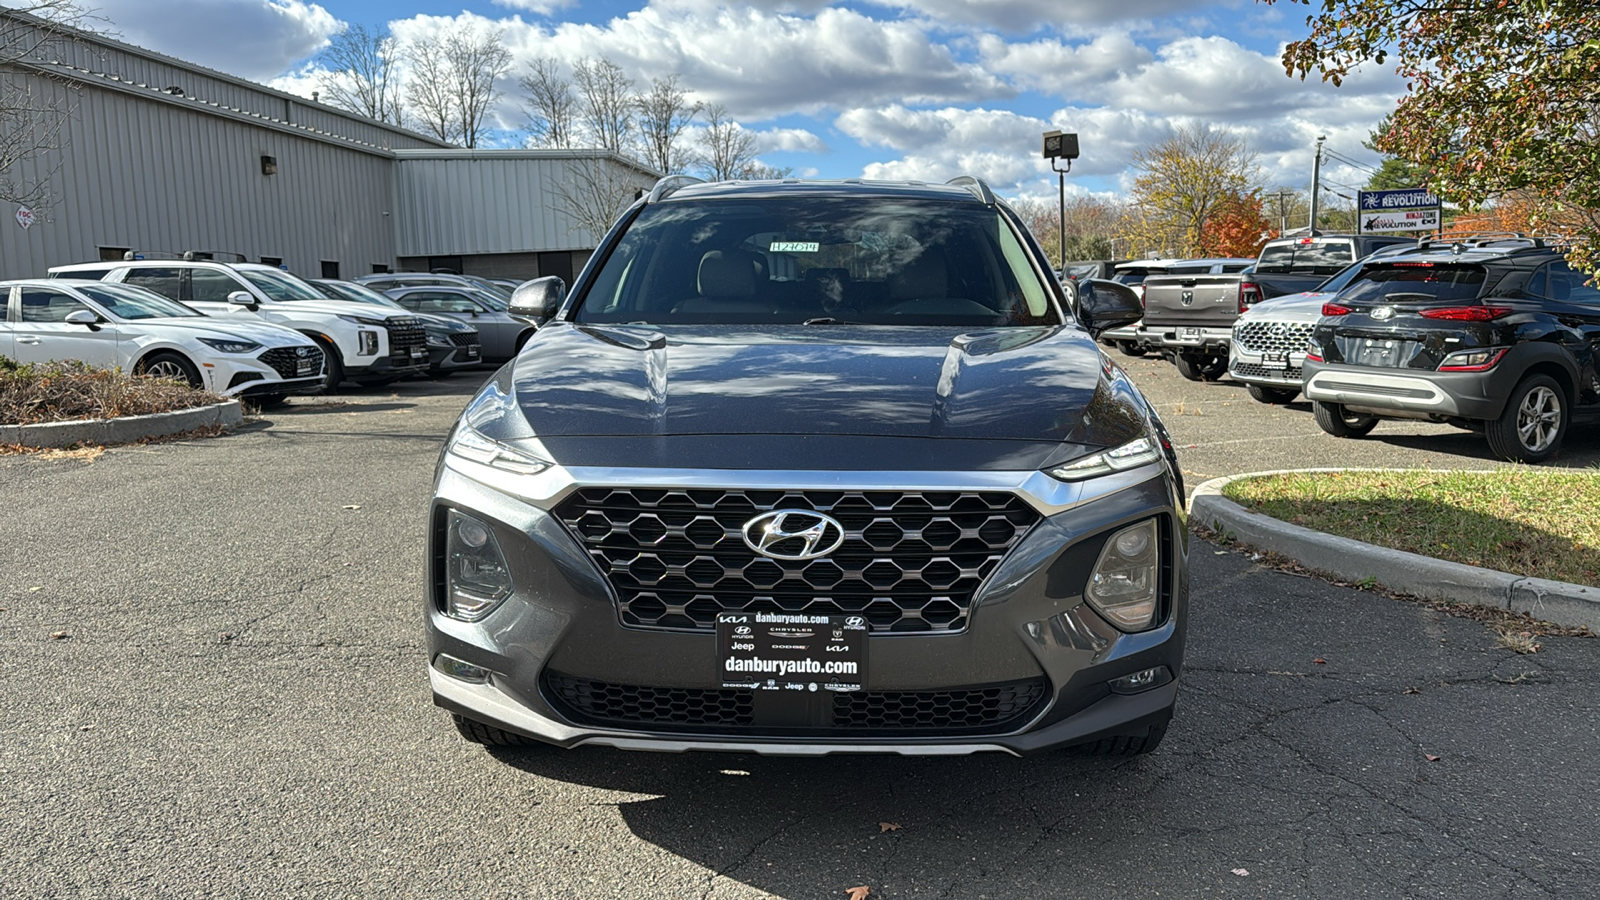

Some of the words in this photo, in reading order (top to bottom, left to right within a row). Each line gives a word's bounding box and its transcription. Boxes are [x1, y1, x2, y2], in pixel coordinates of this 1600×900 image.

[1382, 194, 1437, 206] REVOLUTION
[756, 611, 829, 624] danburyauto.com
[731, 641, 755, 651] Jeep
[725, 656, 858, 676] danburyauto.com
[784, 682, 804, 691] Jeep
